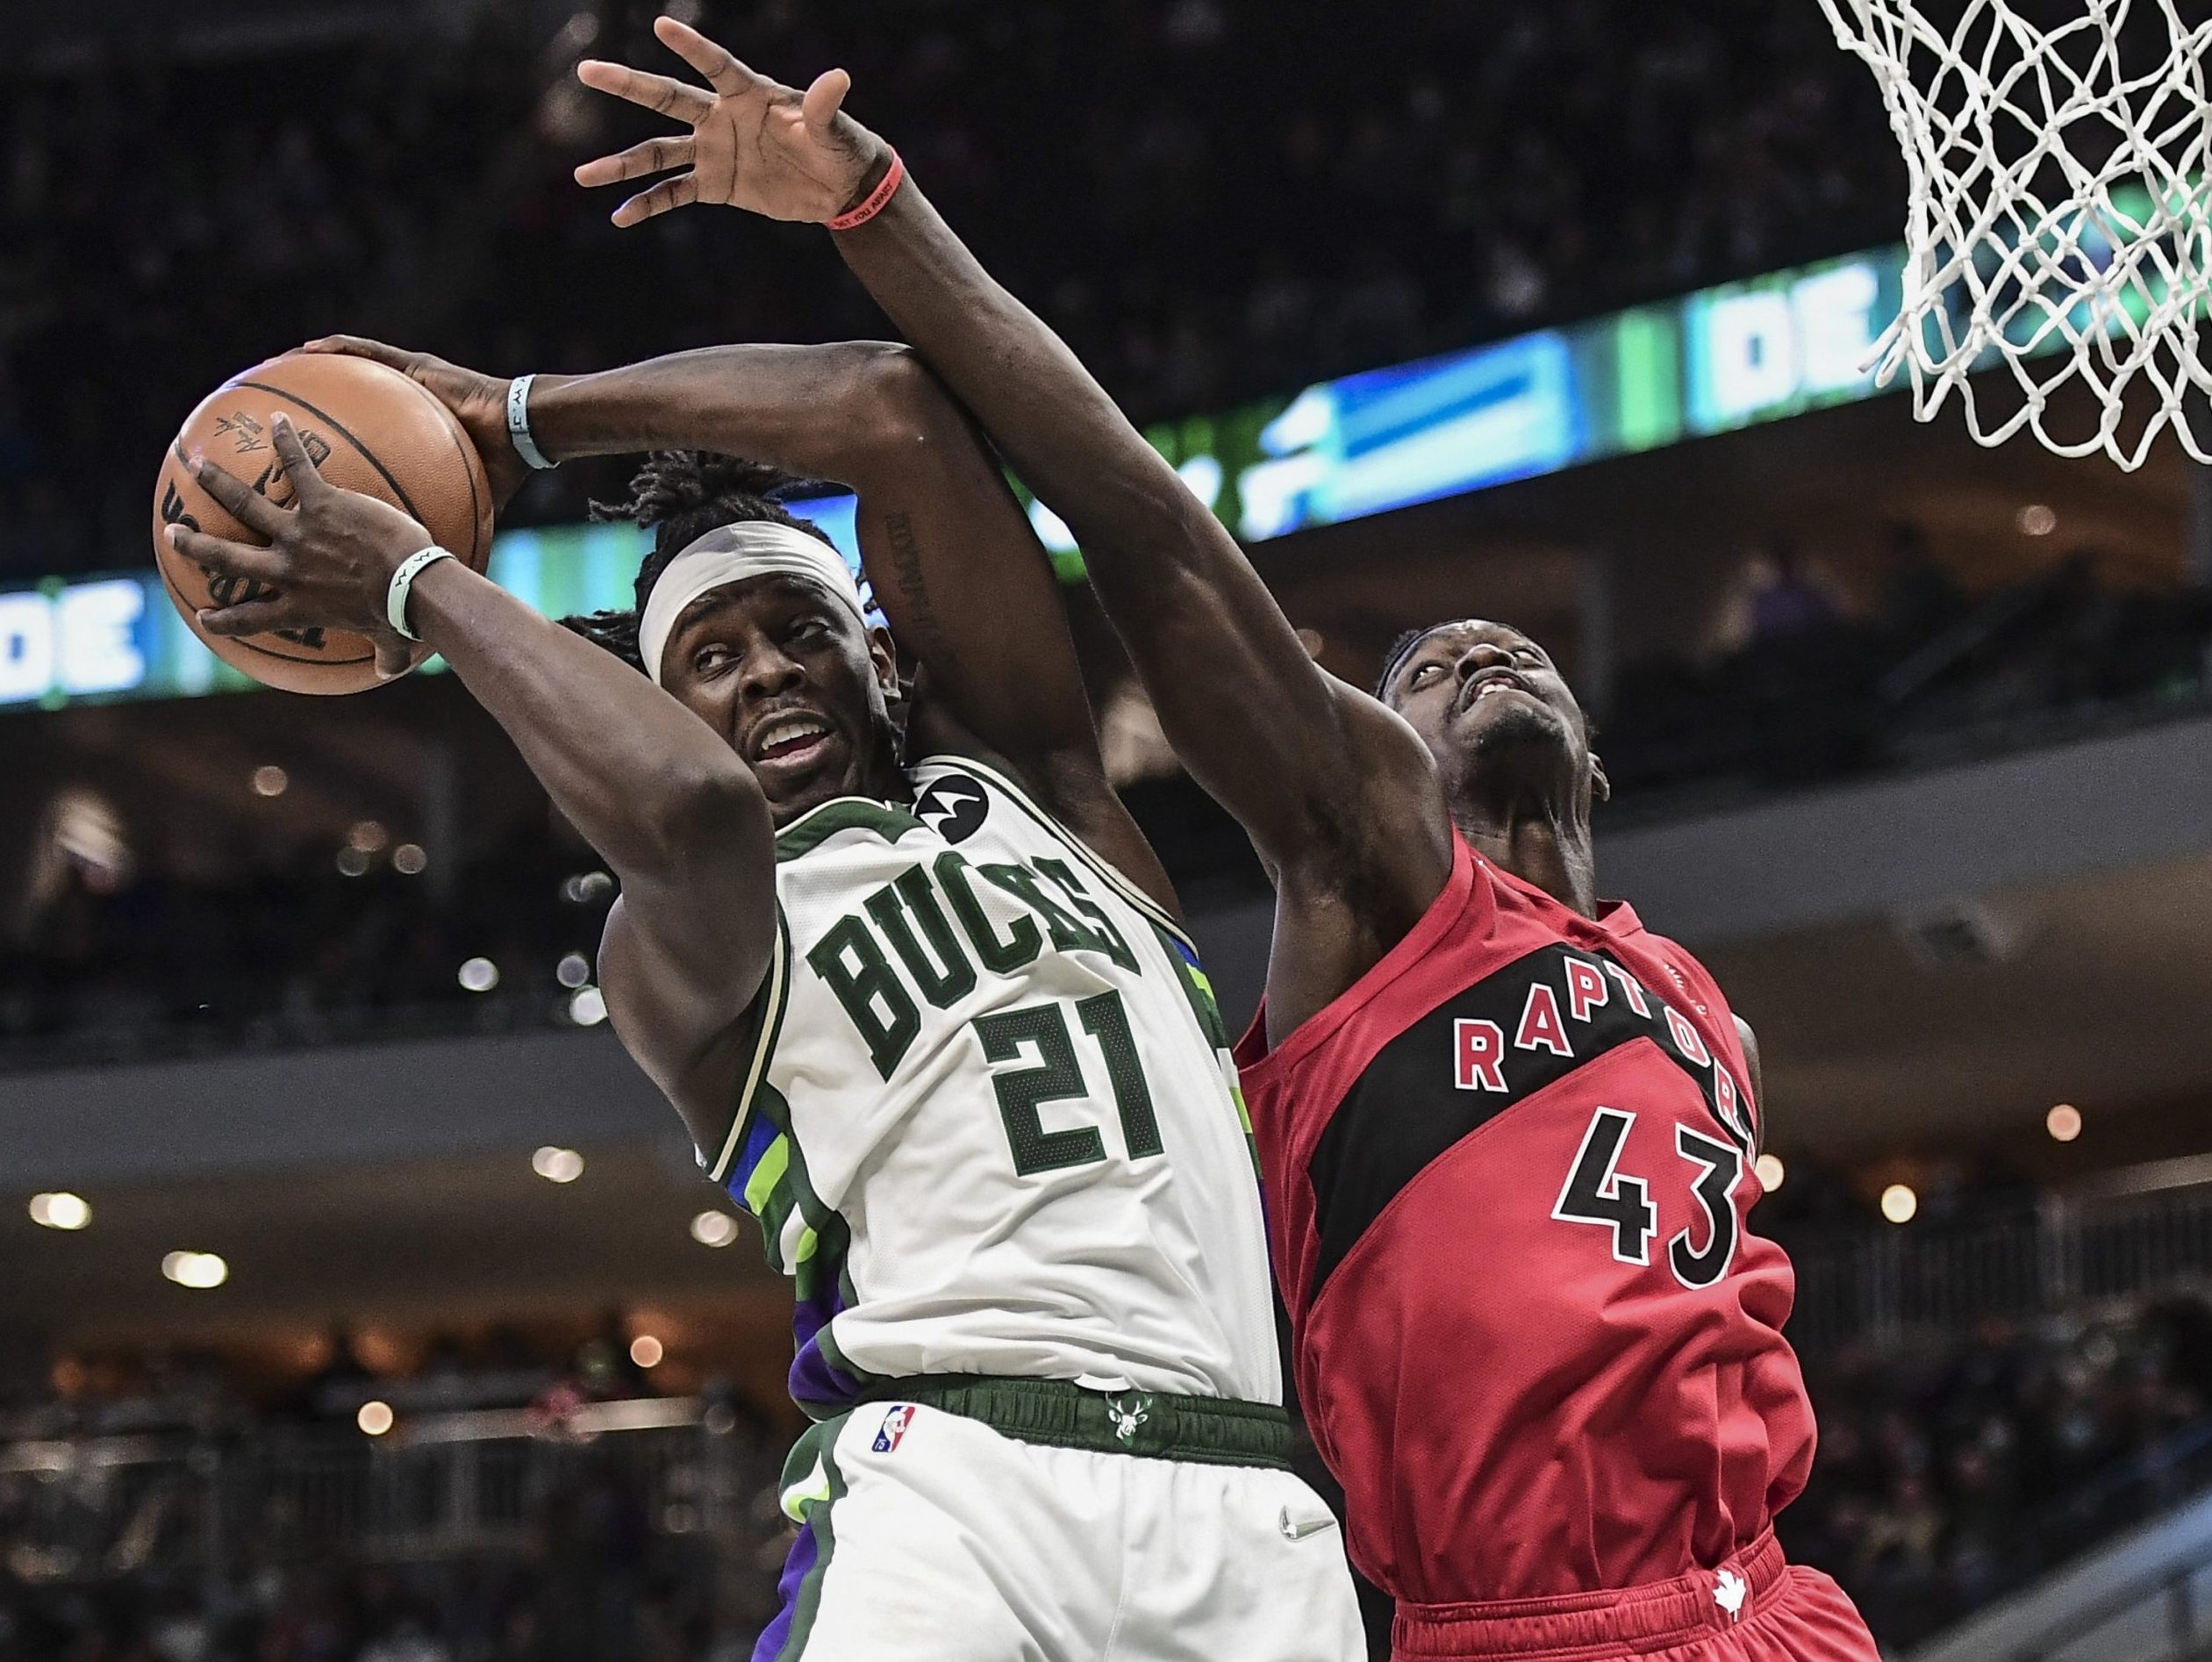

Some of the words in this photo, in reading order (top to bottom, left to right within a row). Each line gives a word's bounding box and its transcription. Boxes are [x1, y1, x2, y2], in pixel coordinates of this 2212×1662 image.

[805, 850, 1142, 1085] BUCKS
[970, 989, 1165, 1178] 21
[1550, 1106, 1744, 1291] 43
